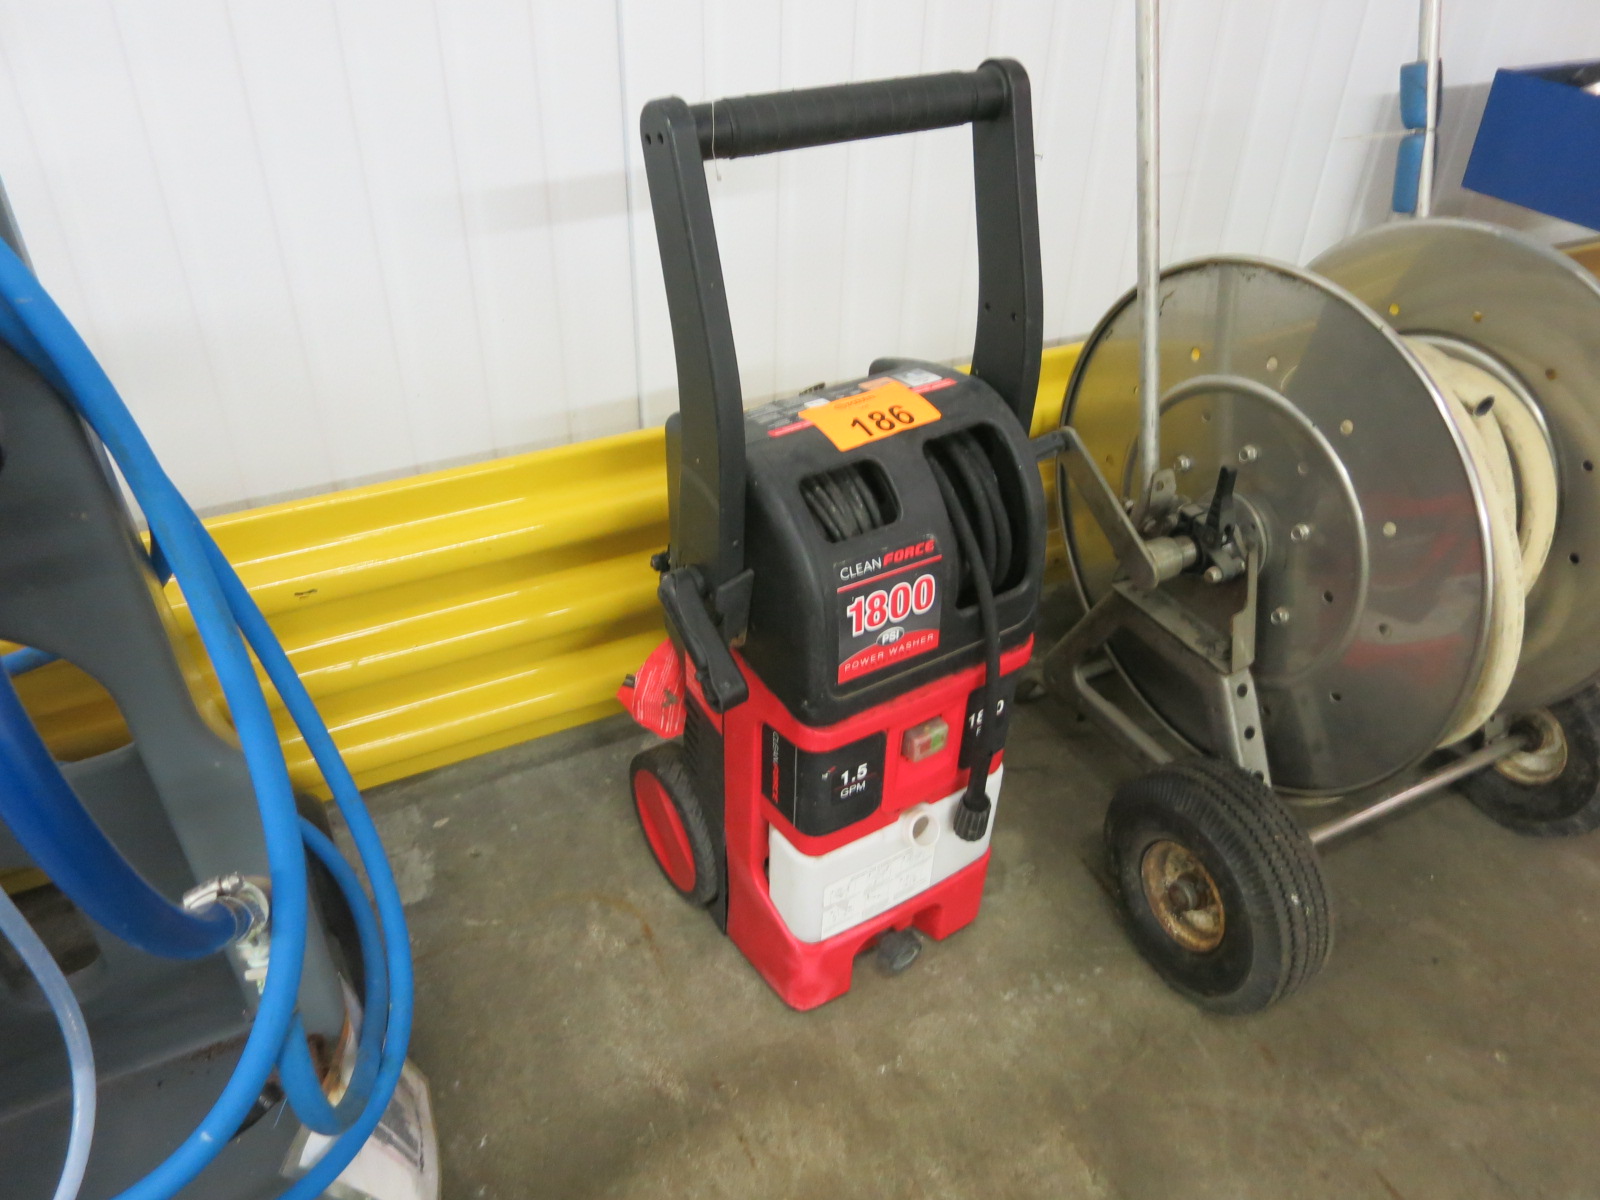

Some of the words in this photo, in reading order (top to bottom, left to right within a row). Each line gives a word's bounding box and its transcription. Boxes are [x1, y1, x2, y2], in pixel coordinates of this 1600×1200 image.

[851, 405, 915, 437] 186
[846, 574, 936, 637] 1800
[881, 630, 900, 646] PSI
[844, 652, 884, 672] POWER
[889, 633, 934, 655] WASHER
[841, 762, 868, 786] 1.5
[840, 780, 866, 799] GPM
